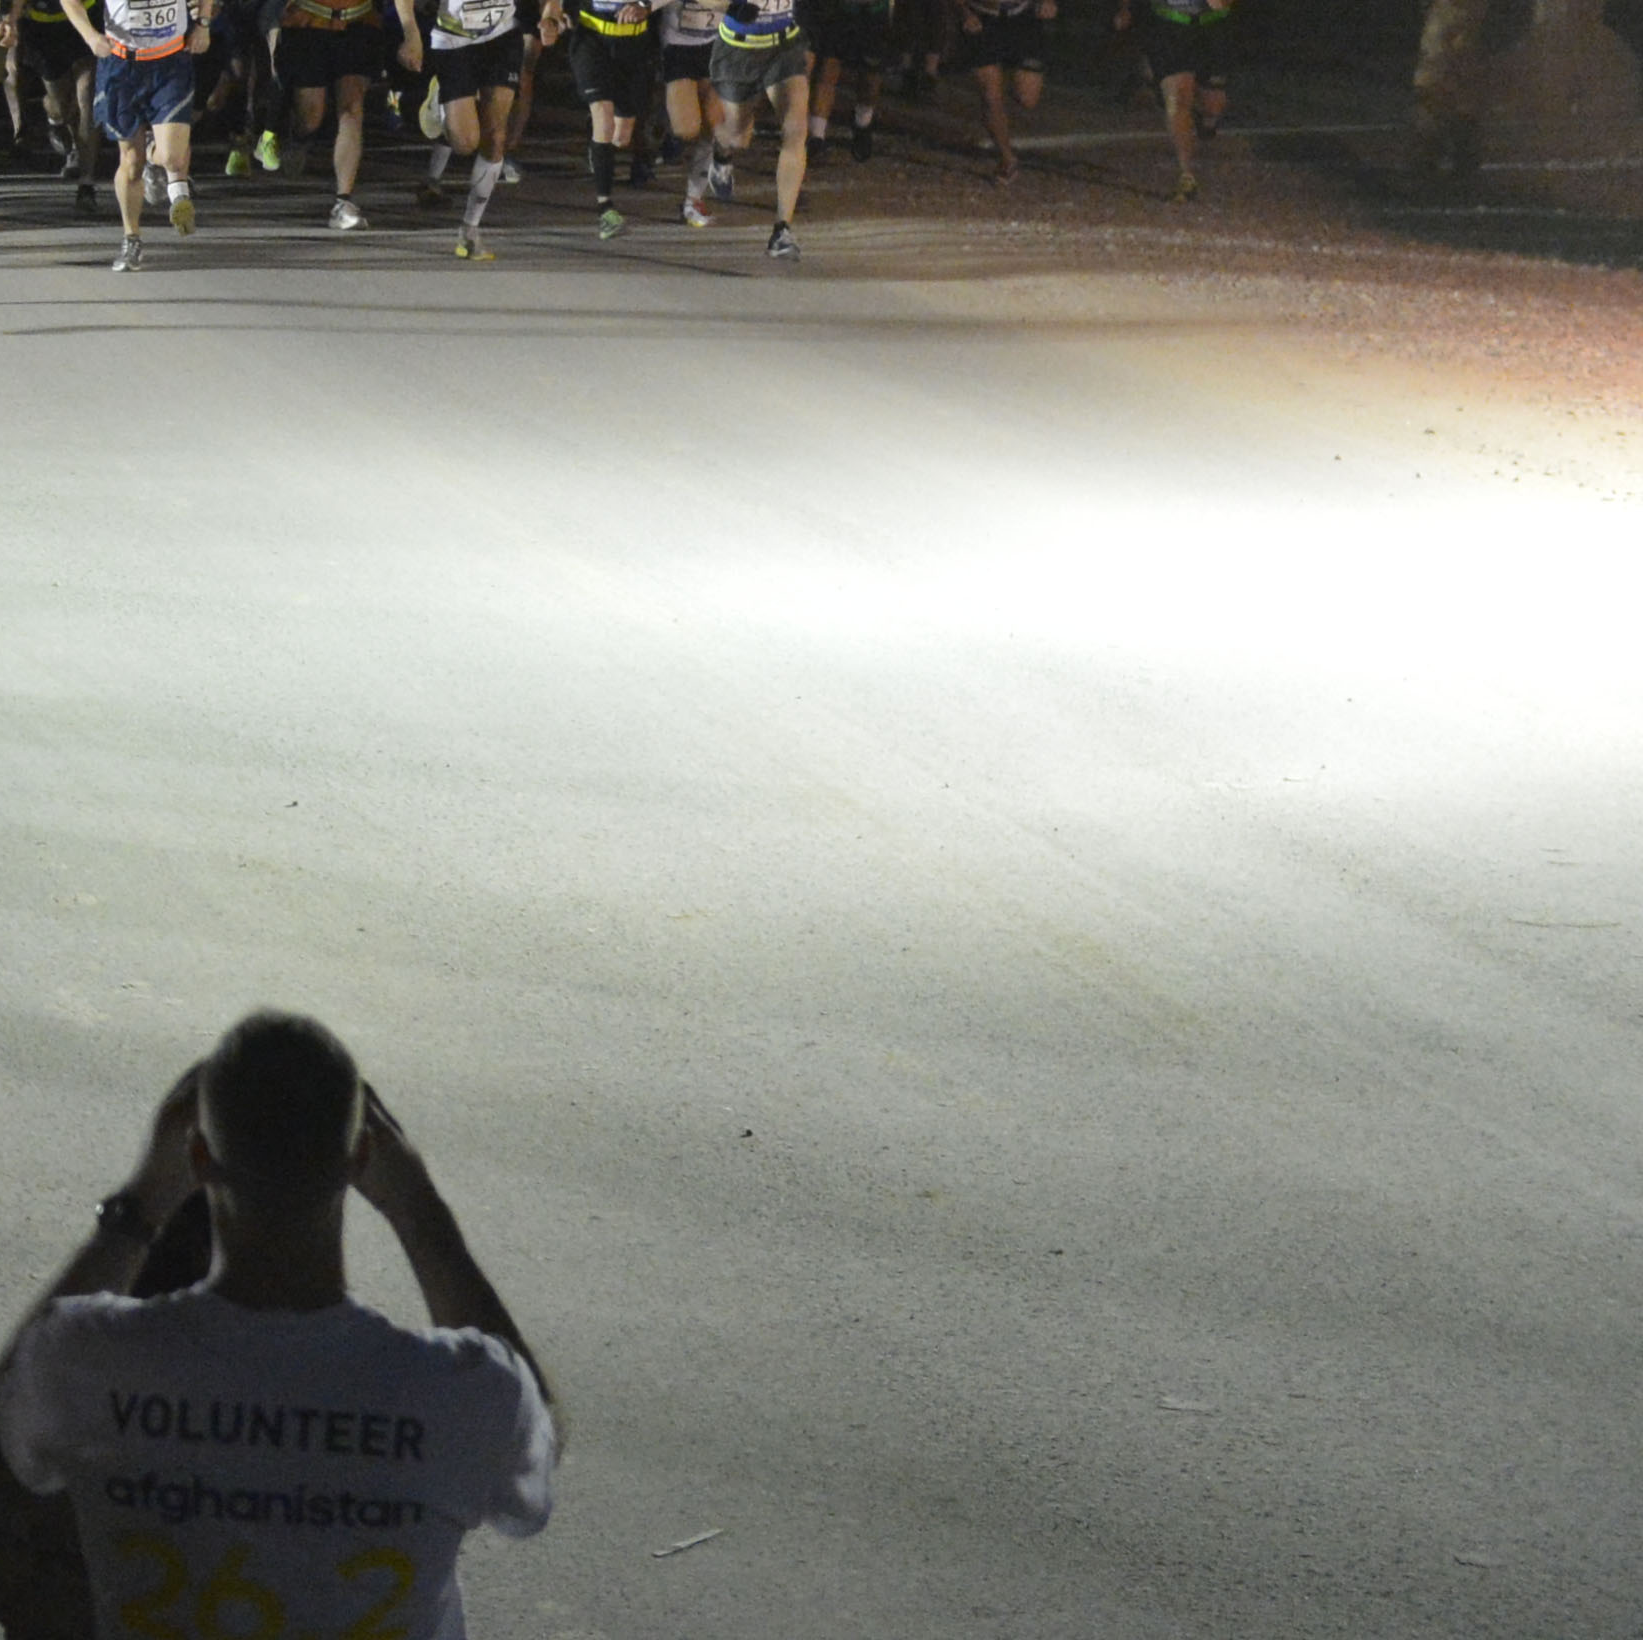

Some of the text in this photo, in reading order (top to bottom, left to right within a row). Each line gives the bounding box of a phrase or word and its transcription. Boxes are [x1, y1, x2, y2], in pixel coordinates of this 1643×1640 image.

[142, 7, 175, 27] 360
[109, 1391, 426, 1460] VOLUNTEER
[105, 1470, 426, 1530] afghanistan
[119, 1535, 415, 1640] 262
